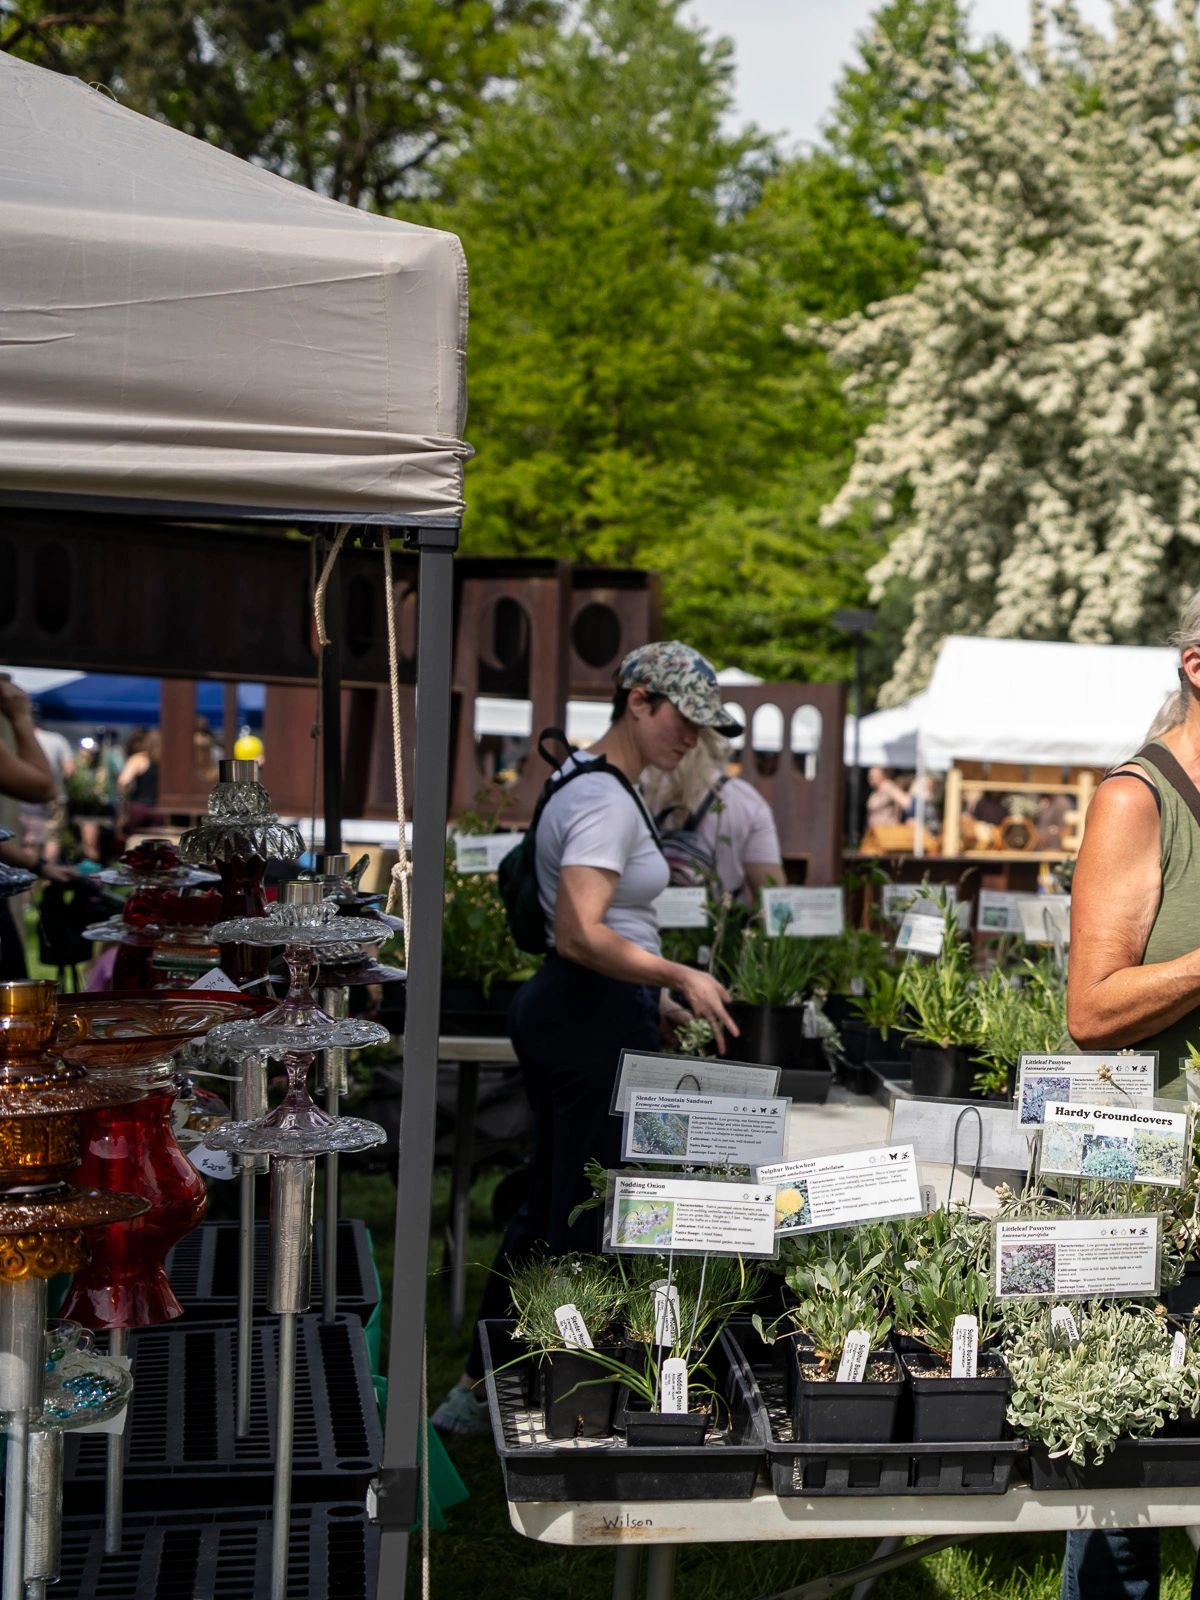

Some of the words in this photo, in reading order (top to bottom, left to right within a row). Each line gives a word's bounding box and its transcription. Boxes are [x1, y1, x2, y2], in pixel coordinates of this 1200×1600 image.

[636, 1095, 656, 1103] Slender
[686, 1097, 713, 1105] Sandwort
[1055, 1106, 1090, 1119] Hardy
[1094, 1111, 1173, 1126] Groundcovers
[761, 1167, 783, 1175] Sulphur
[785, 1162, 816, 1171] Buckwheat
[620, 1181, 645, 1189] Nodding
[856, 1344, 866, 1363] Sulphur
[603, 1513, 653, 1529] Wilson
